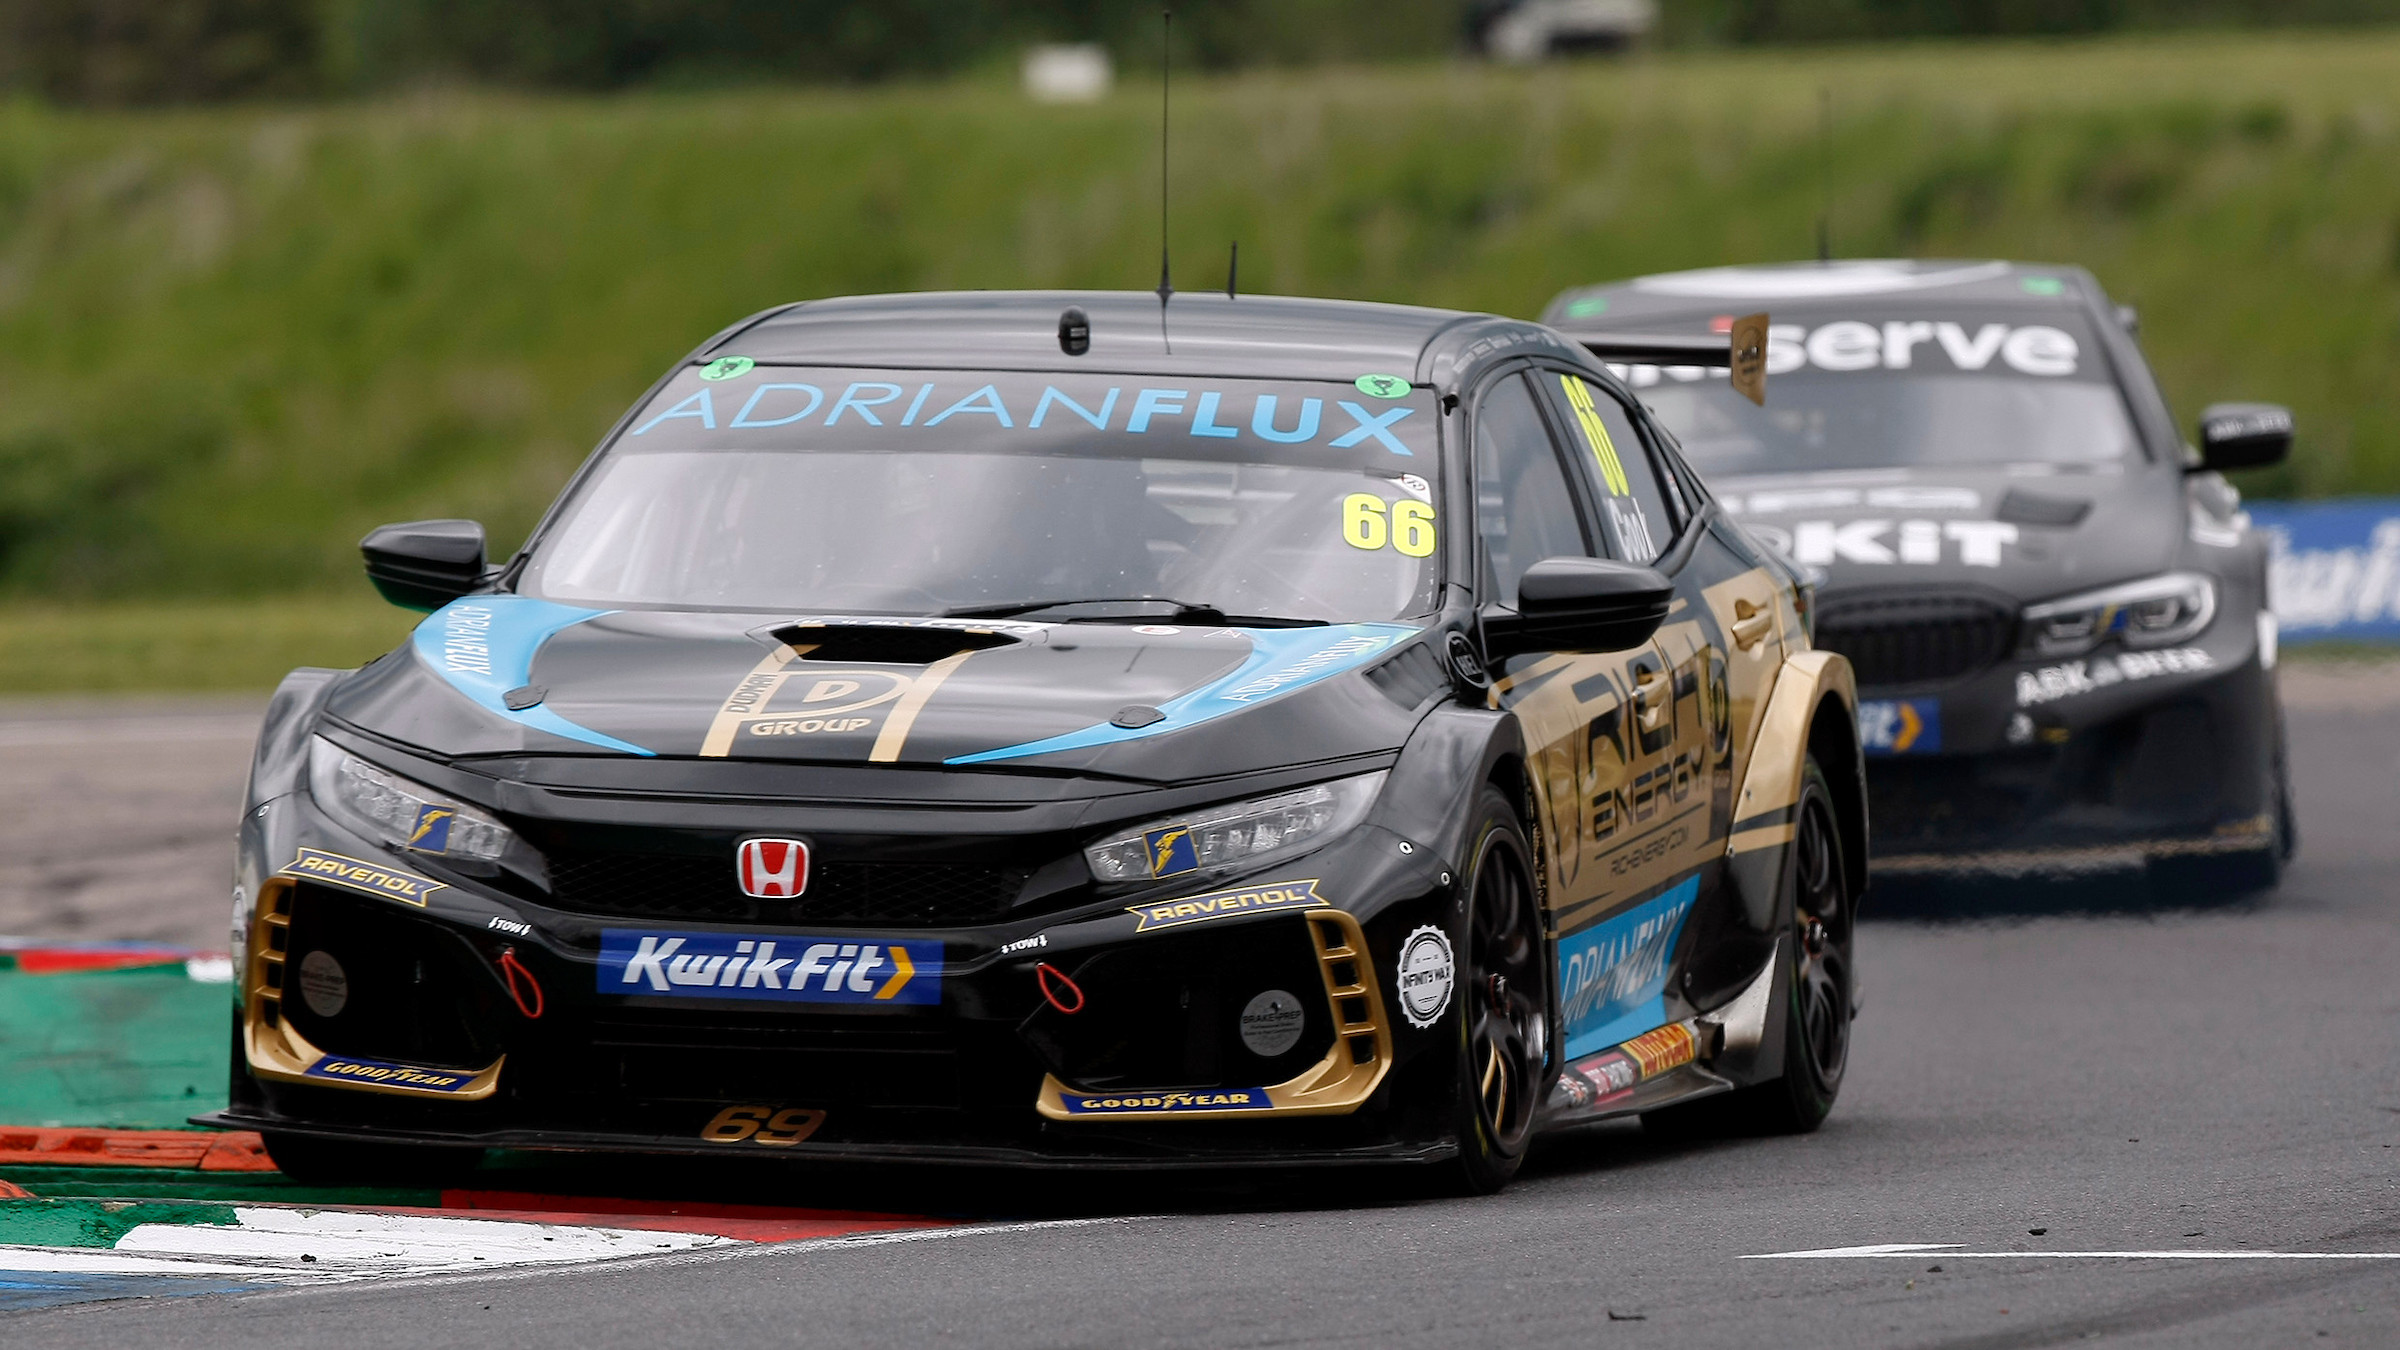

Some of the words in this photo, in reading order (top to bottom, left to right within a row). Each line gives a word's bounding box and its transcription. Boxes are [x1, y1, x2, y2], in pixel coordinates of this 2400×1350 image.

[633, 382, 1415, 456] ADRIANFLUX
[1561, 373, 1630, 497] 66
[1342, 493, 1437, 558] 66
[751, 718, 873, 736] GROUP
[1592, 745, 1706, 842] ENERGY
[300, 856, 419, 896] RAVENOL
[1150, 888, 1307, 922] RAVENOL
[324, 1062, 458, 1087] GOODYEAR
[1081, 1092, 1250, 1110] GOODYEAR
[701, 1104, 828, 1147] 69
